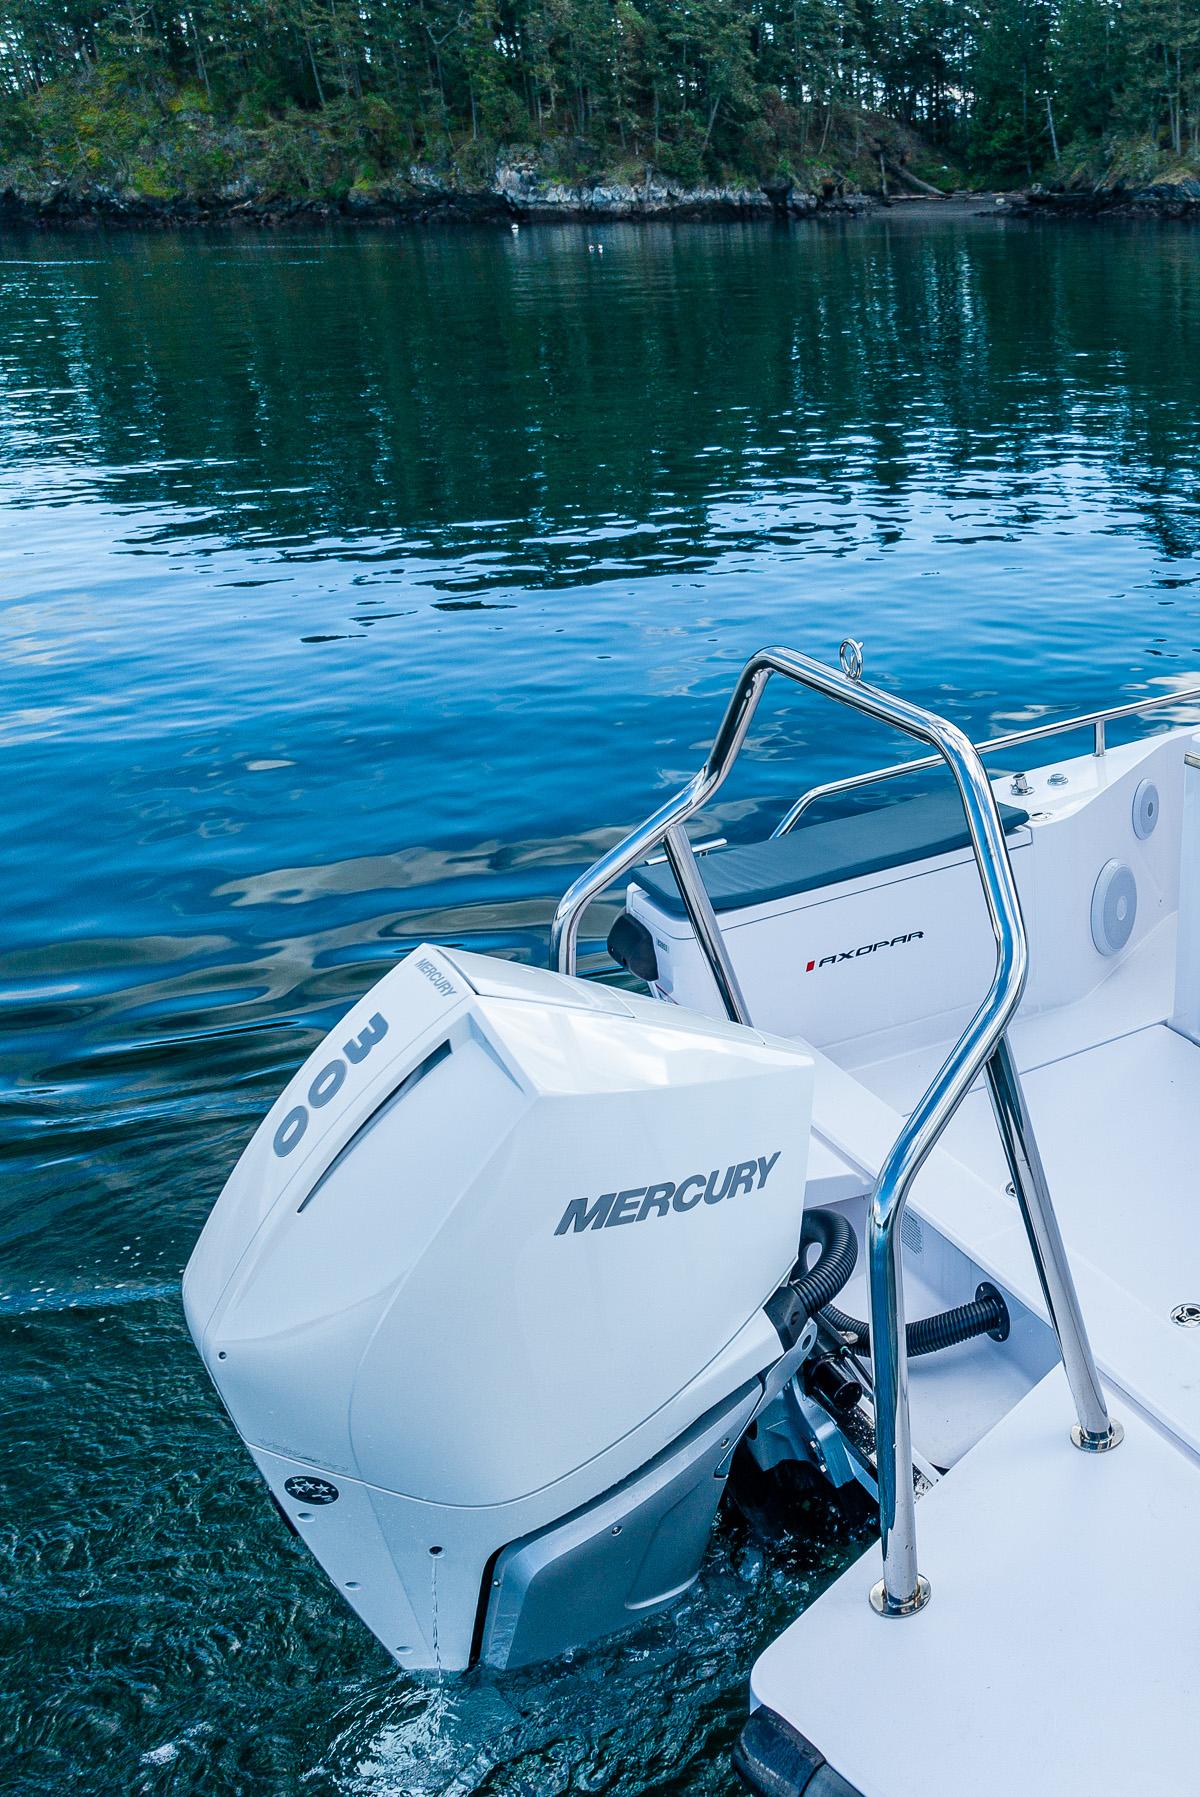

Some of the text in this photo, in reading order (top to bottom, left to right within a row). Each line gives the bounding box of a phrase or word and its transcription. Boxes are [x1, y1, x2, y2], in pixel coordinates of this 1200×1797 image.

[414, 958, 457, 997] MERCURY
[818, 930, 924, 968] AXOPAR
[272, 1011, 390, 1158] 300
[553, 1150, 782, 1236] MERCURY
